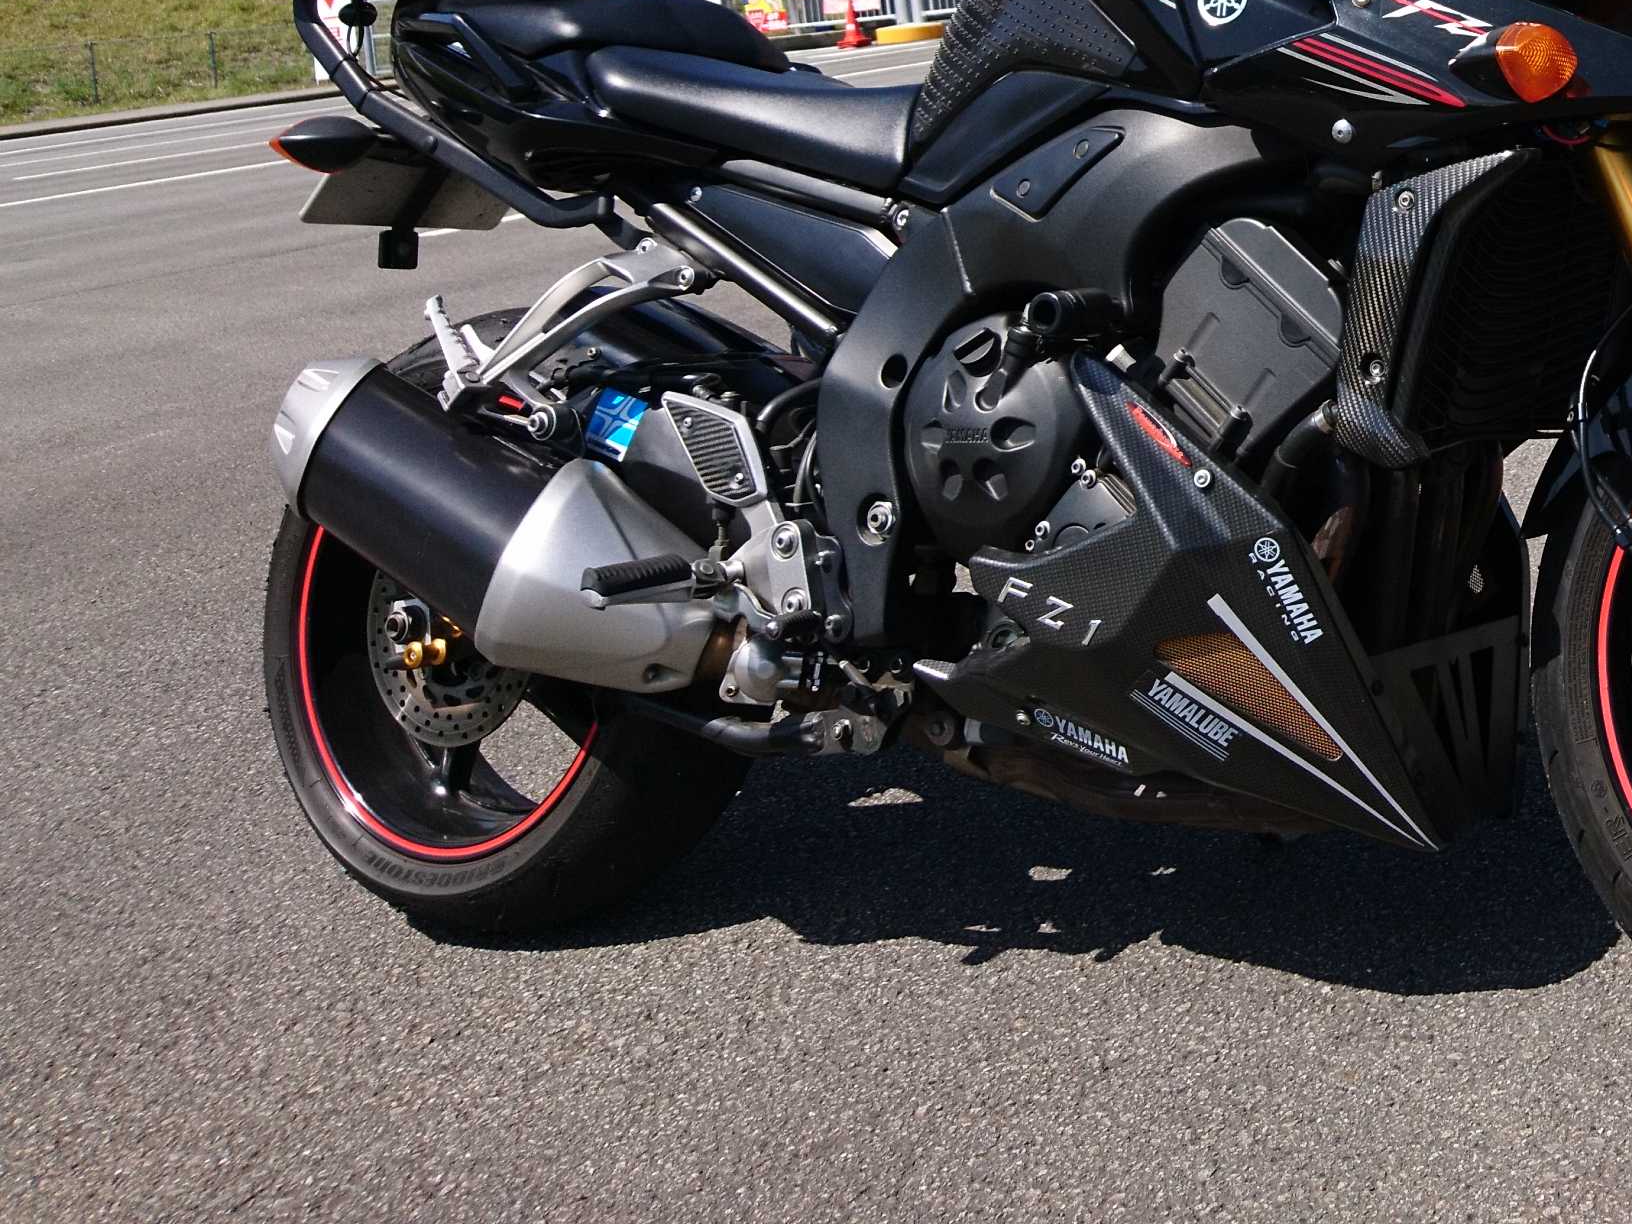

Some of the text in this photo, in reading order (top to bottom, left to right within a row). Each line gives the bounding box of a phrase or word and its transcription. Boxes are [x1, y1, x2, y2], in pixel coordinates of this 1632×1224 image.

[997, 577, 1103, 646] FZ1
[1248, 553, 1300, 641] RACING
[1266, 559, 1324, 644] YAMAHA
[1055, 715, 1129, 764] YAMAHA
[1147, 678, 1233, 747] YAMALUBE
